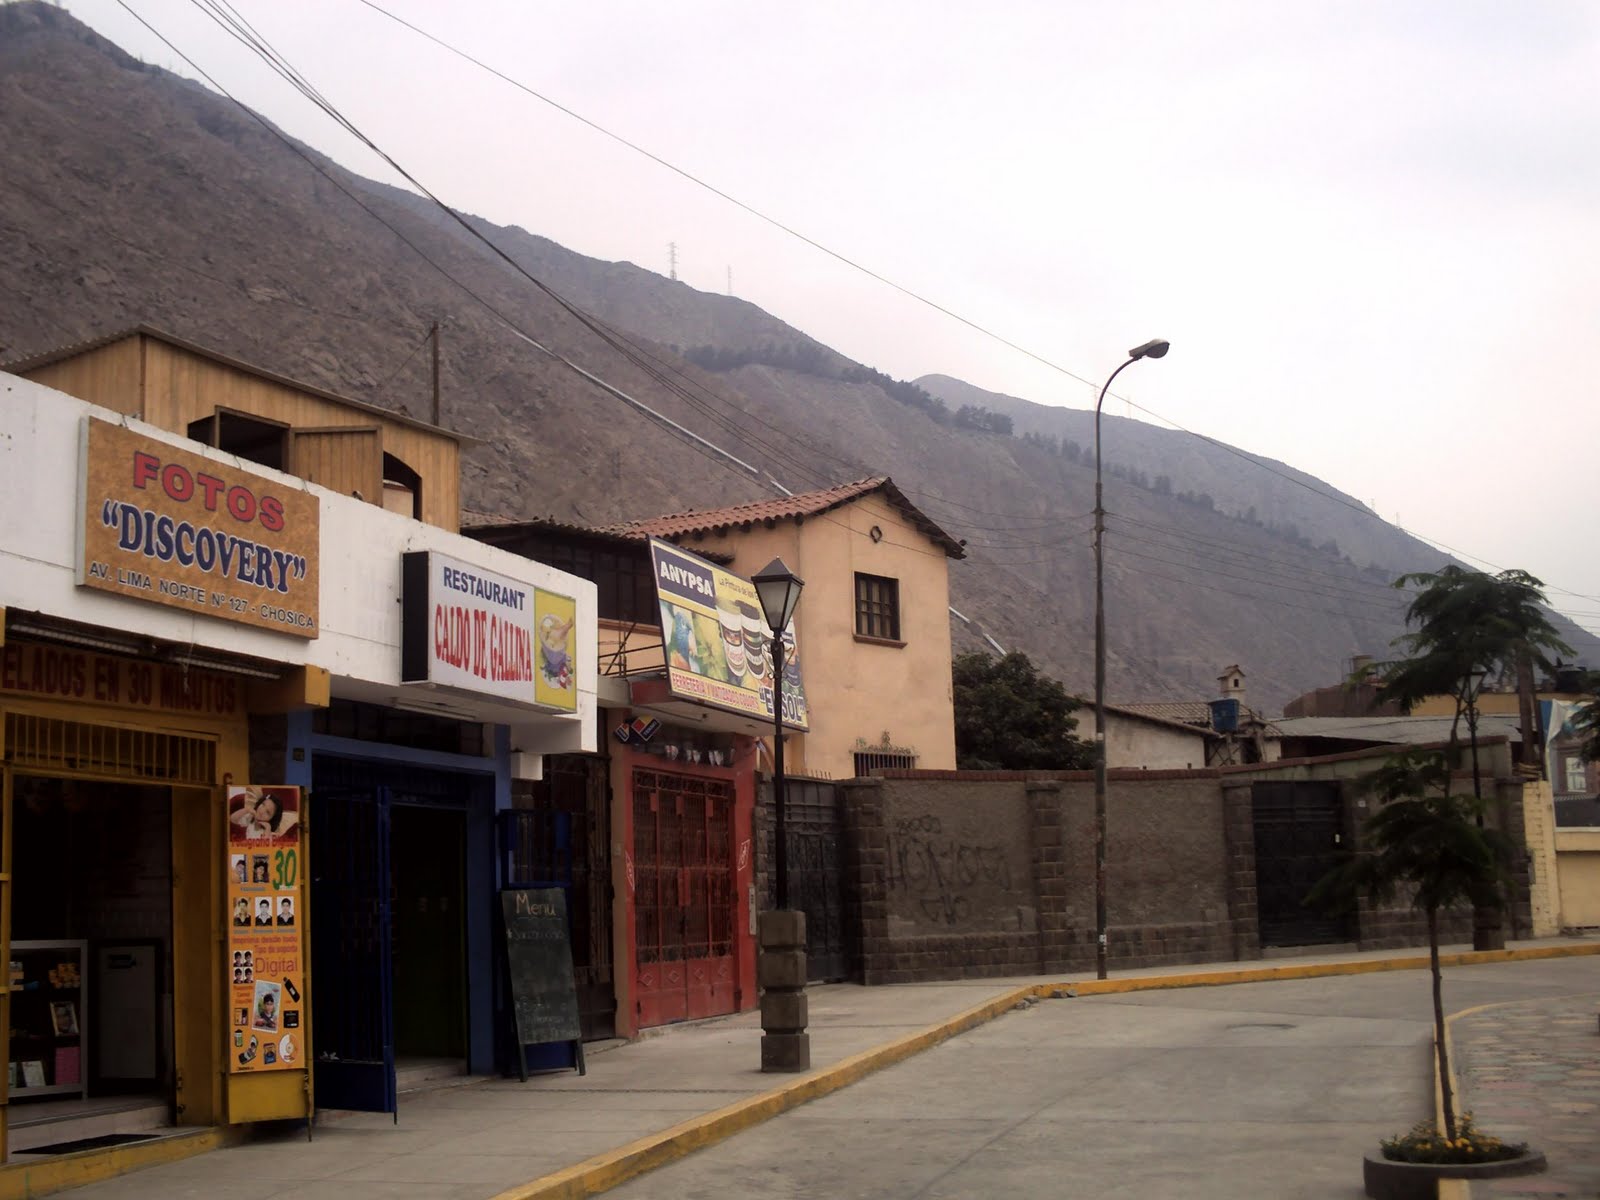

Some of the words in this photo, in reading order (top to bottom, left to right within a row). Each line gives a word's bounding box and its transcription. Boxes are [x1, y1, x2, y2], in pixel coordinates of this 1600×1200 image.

[133, 451, 285, 531] FOTOS
[89, 561, 112, 581] AV.
[118, 568, 152, 590] LIMA
[159, 579, 205, 604] NORTE
[229, 597, 248, 614] 127
[260, 603, 315, 629] CHOSICA
[443, 566, 525, 611] RESTAURANT
[660, 560, 714, 598] ANYPSA
[434, 603, 471, 672] CALDO
[473, 608, 487, 680] DE
[490, 614, 533, 682] GALLINA
[94, 657, 119, 703] EN
[128, 662, 152, 705] 30
[160, 664, 236, 714] MINUTOS
[272, 848, 297, 891] 30
[255, 957, 298, 977] Digital
